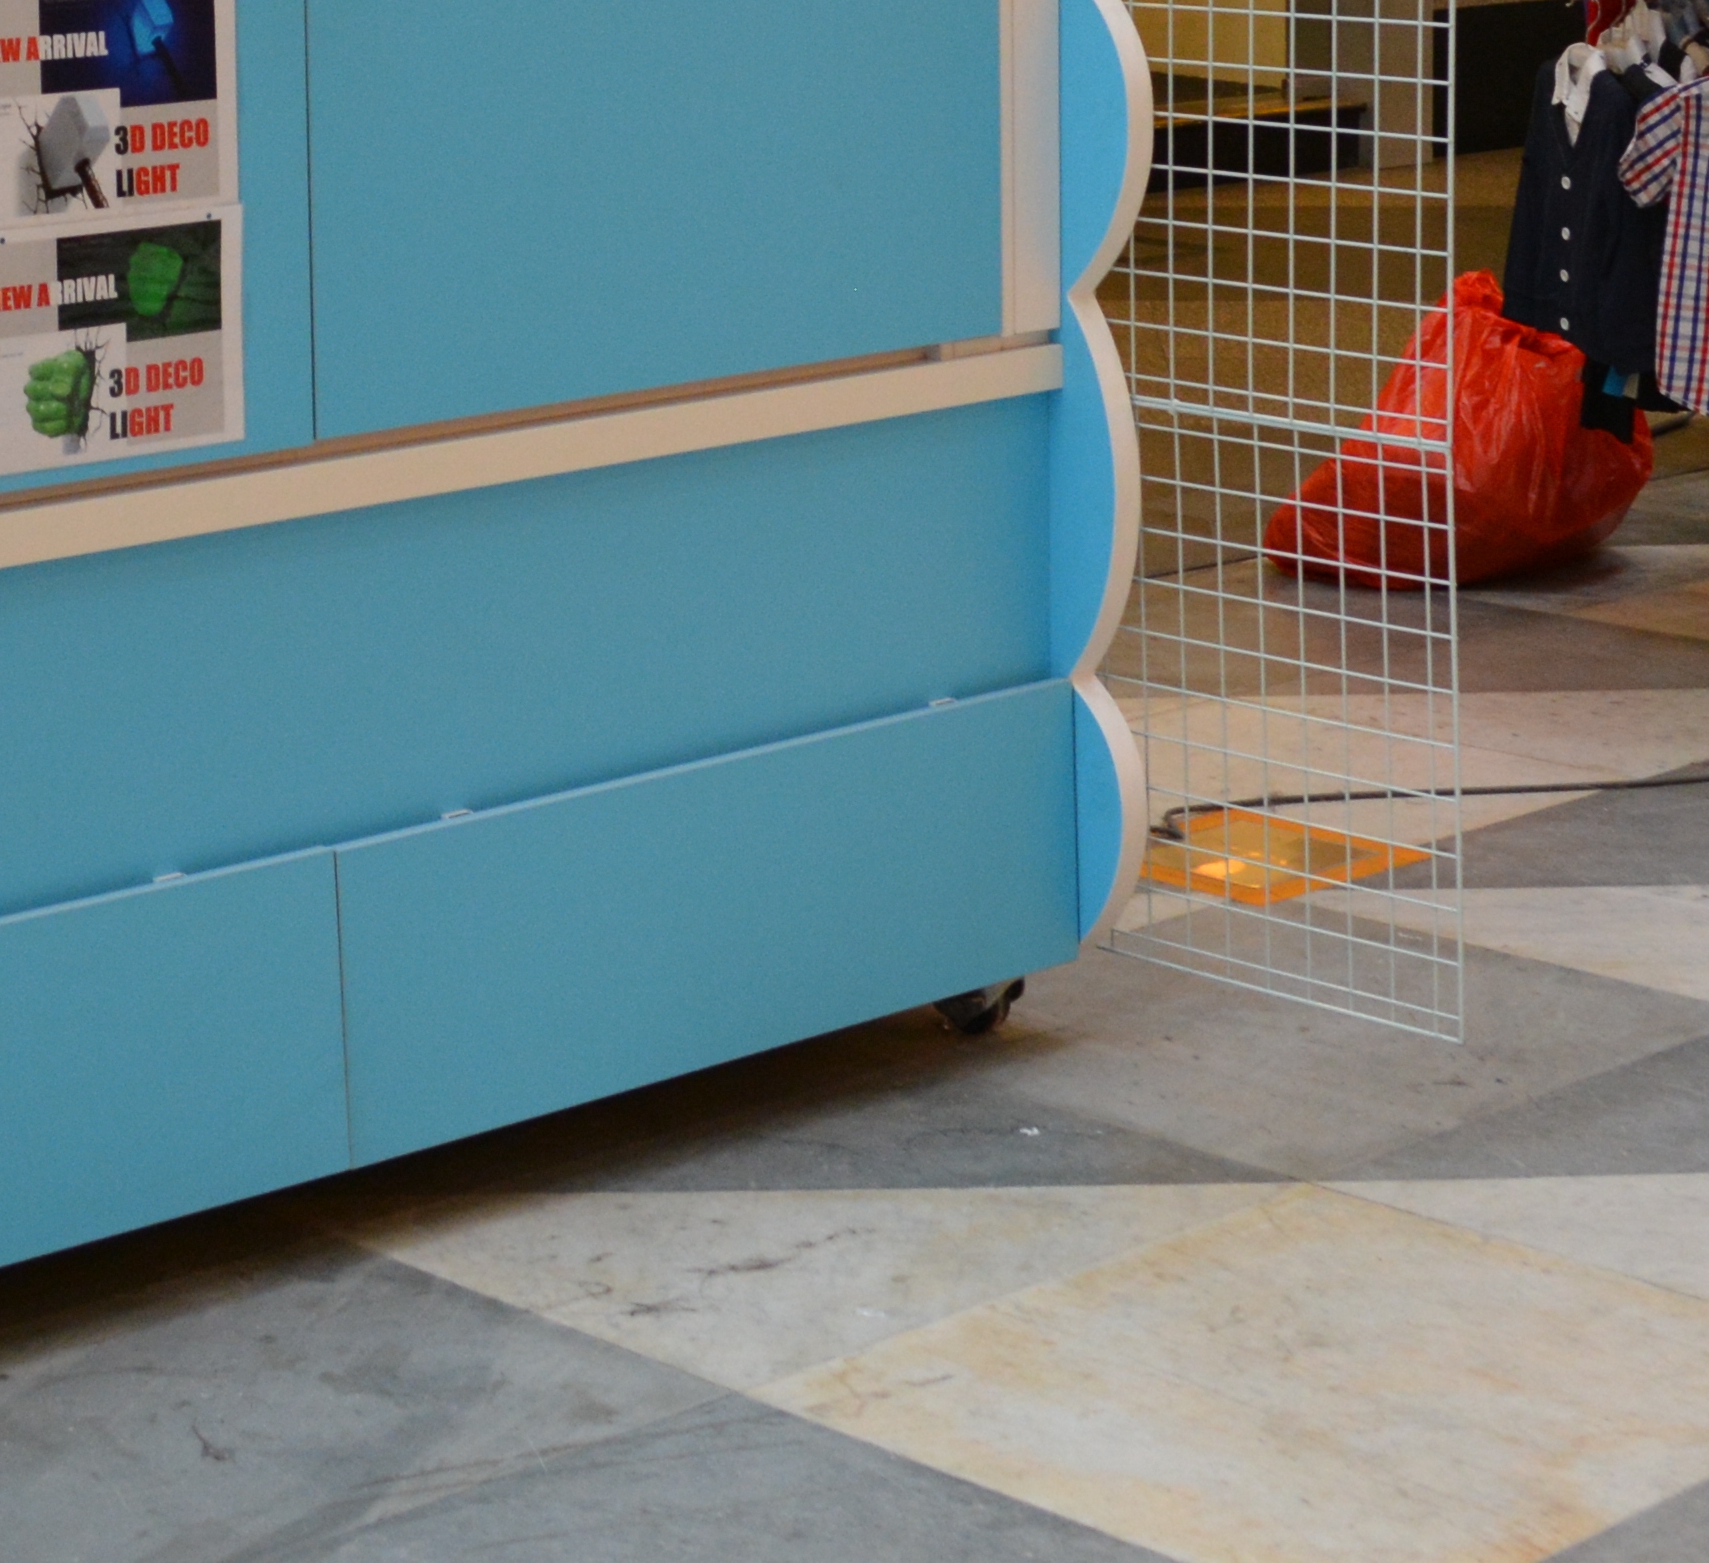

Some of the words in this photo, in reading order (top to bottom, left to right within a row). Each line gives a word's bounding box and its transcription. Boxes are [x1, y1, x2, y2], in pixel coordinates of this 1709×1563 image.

[26, 31, 108, 62] ARRIVAL
[114, 124, 145, 155] 3D
[151, 117, 209, 151] DECO
[116, 163, 180, 198] LIGHT
[109, 367, 140, 398] 3D
[146, 357, 204, 393] DECO
[109, 403, 174, 441] LIGHT
